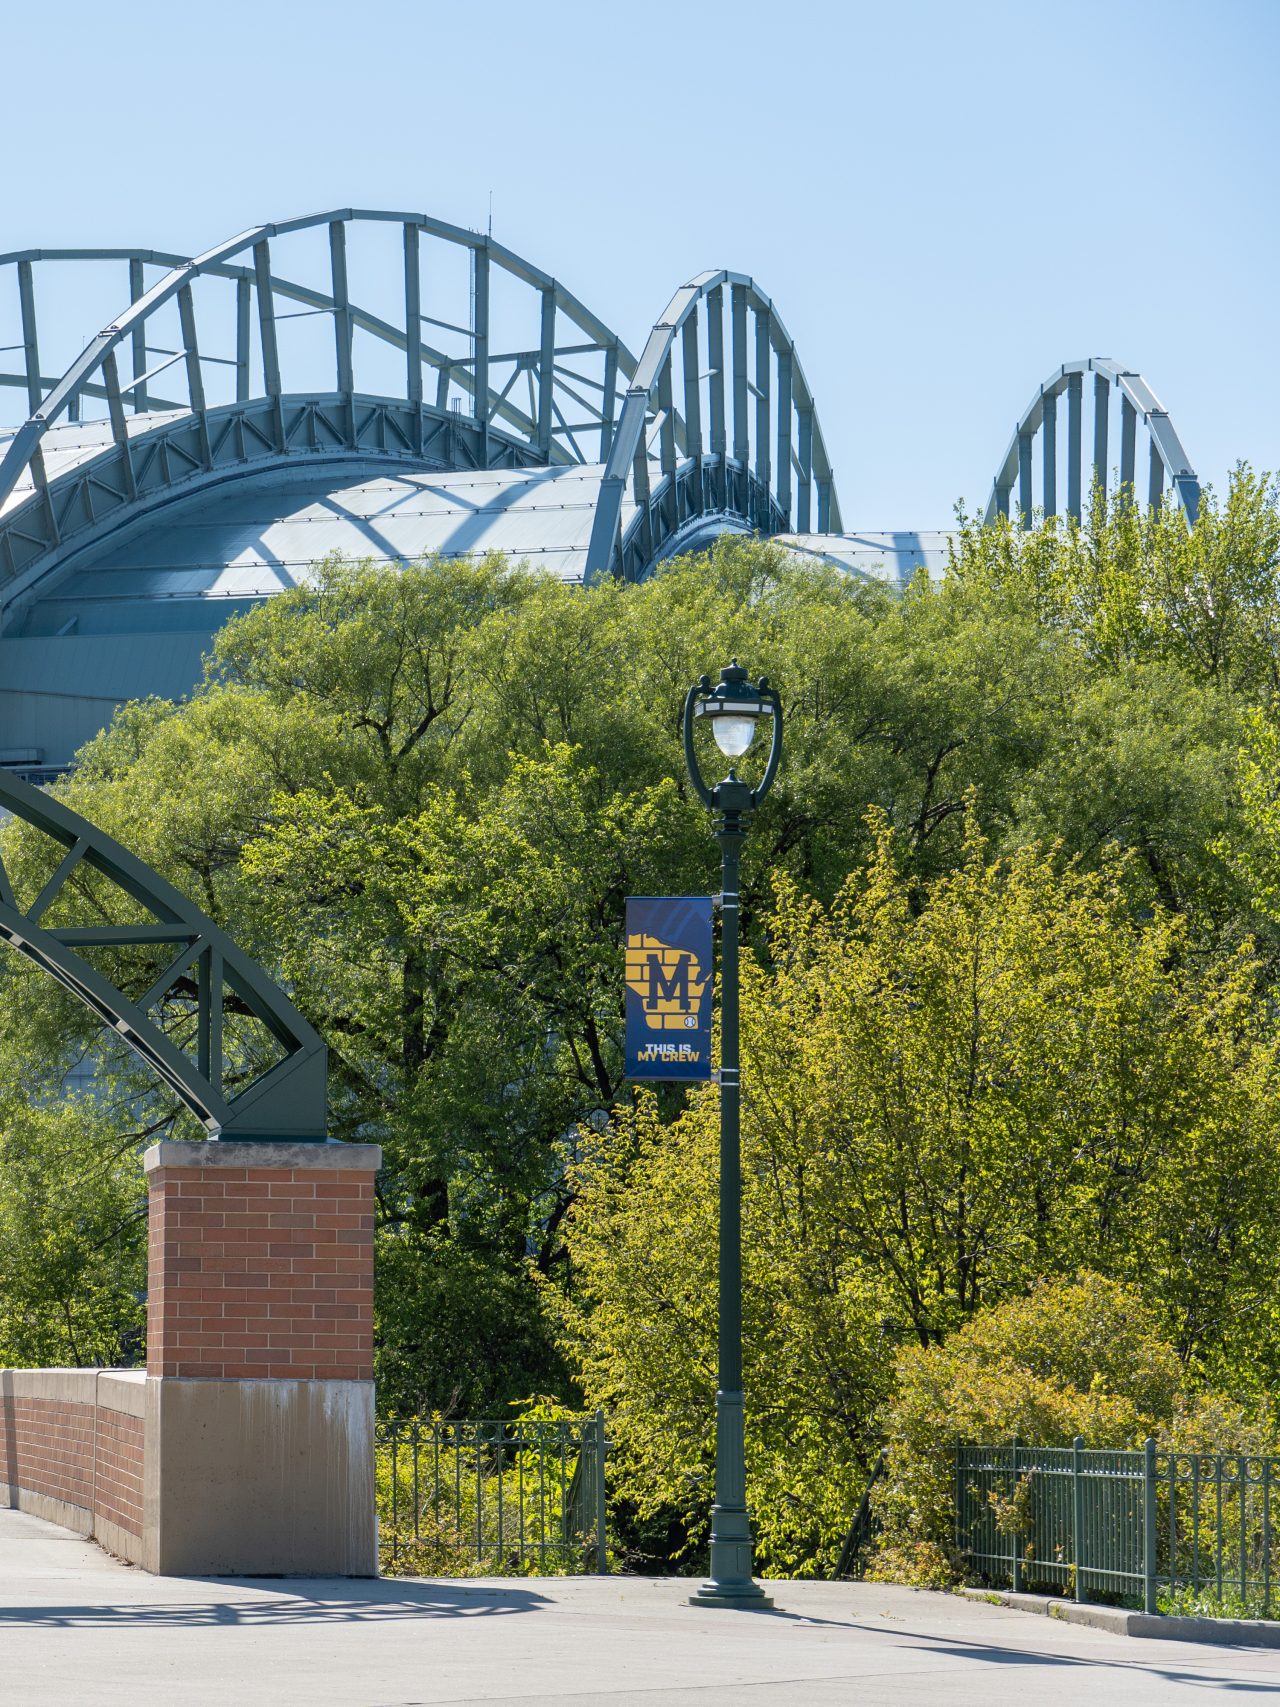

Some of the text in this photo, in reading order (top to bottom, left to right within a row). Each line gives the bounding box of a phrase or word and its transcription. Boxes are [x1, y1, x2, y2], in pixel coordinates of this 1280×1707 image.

[646, 953, 692, 1010] M
[645, 1043, 692, 1055] THIS IS
[637, 1051, 700, 1062] MY CREW
